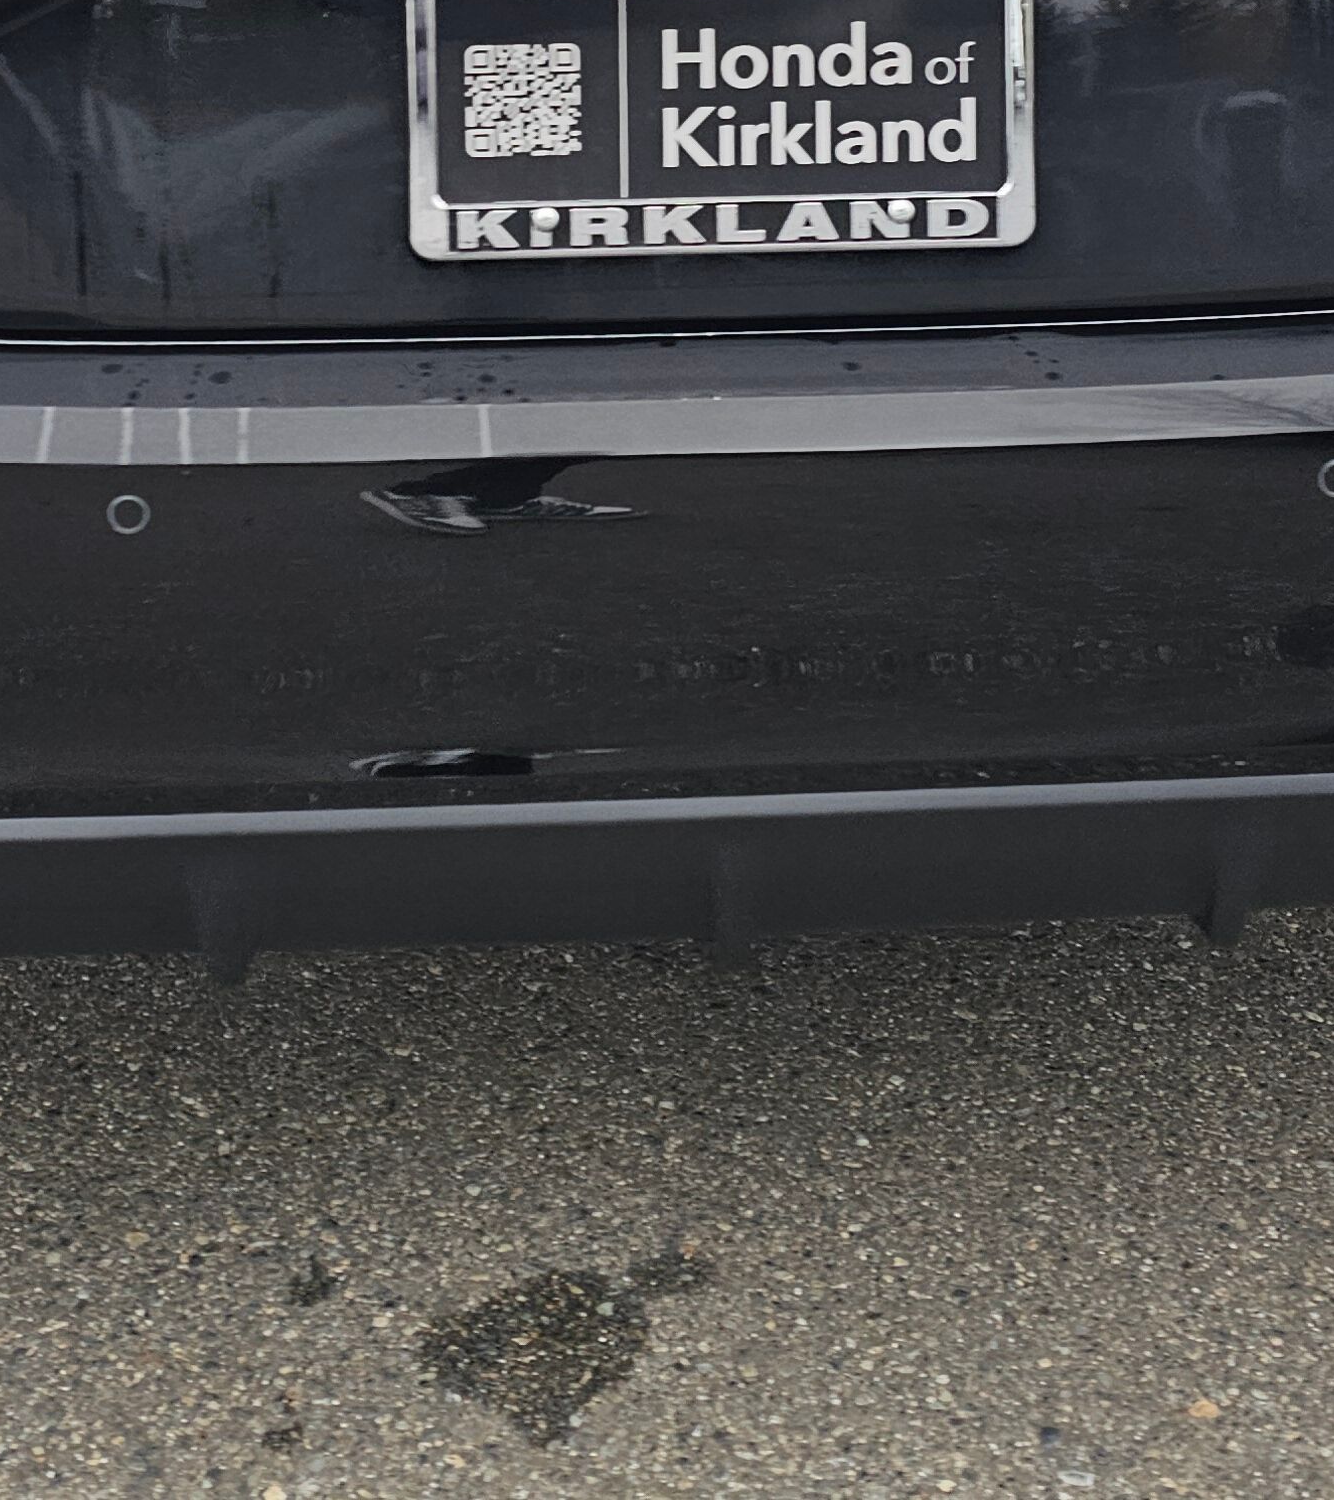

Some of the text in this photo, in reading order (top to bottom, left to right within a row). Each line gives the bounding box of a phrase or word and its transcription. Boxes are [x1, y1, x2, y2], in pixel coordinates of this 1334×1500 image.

[661, 21, 977, 90] Honda of
[661, 97, 977, 168] Kirkland
[455, 199, 991, 251] KIRKLAND
